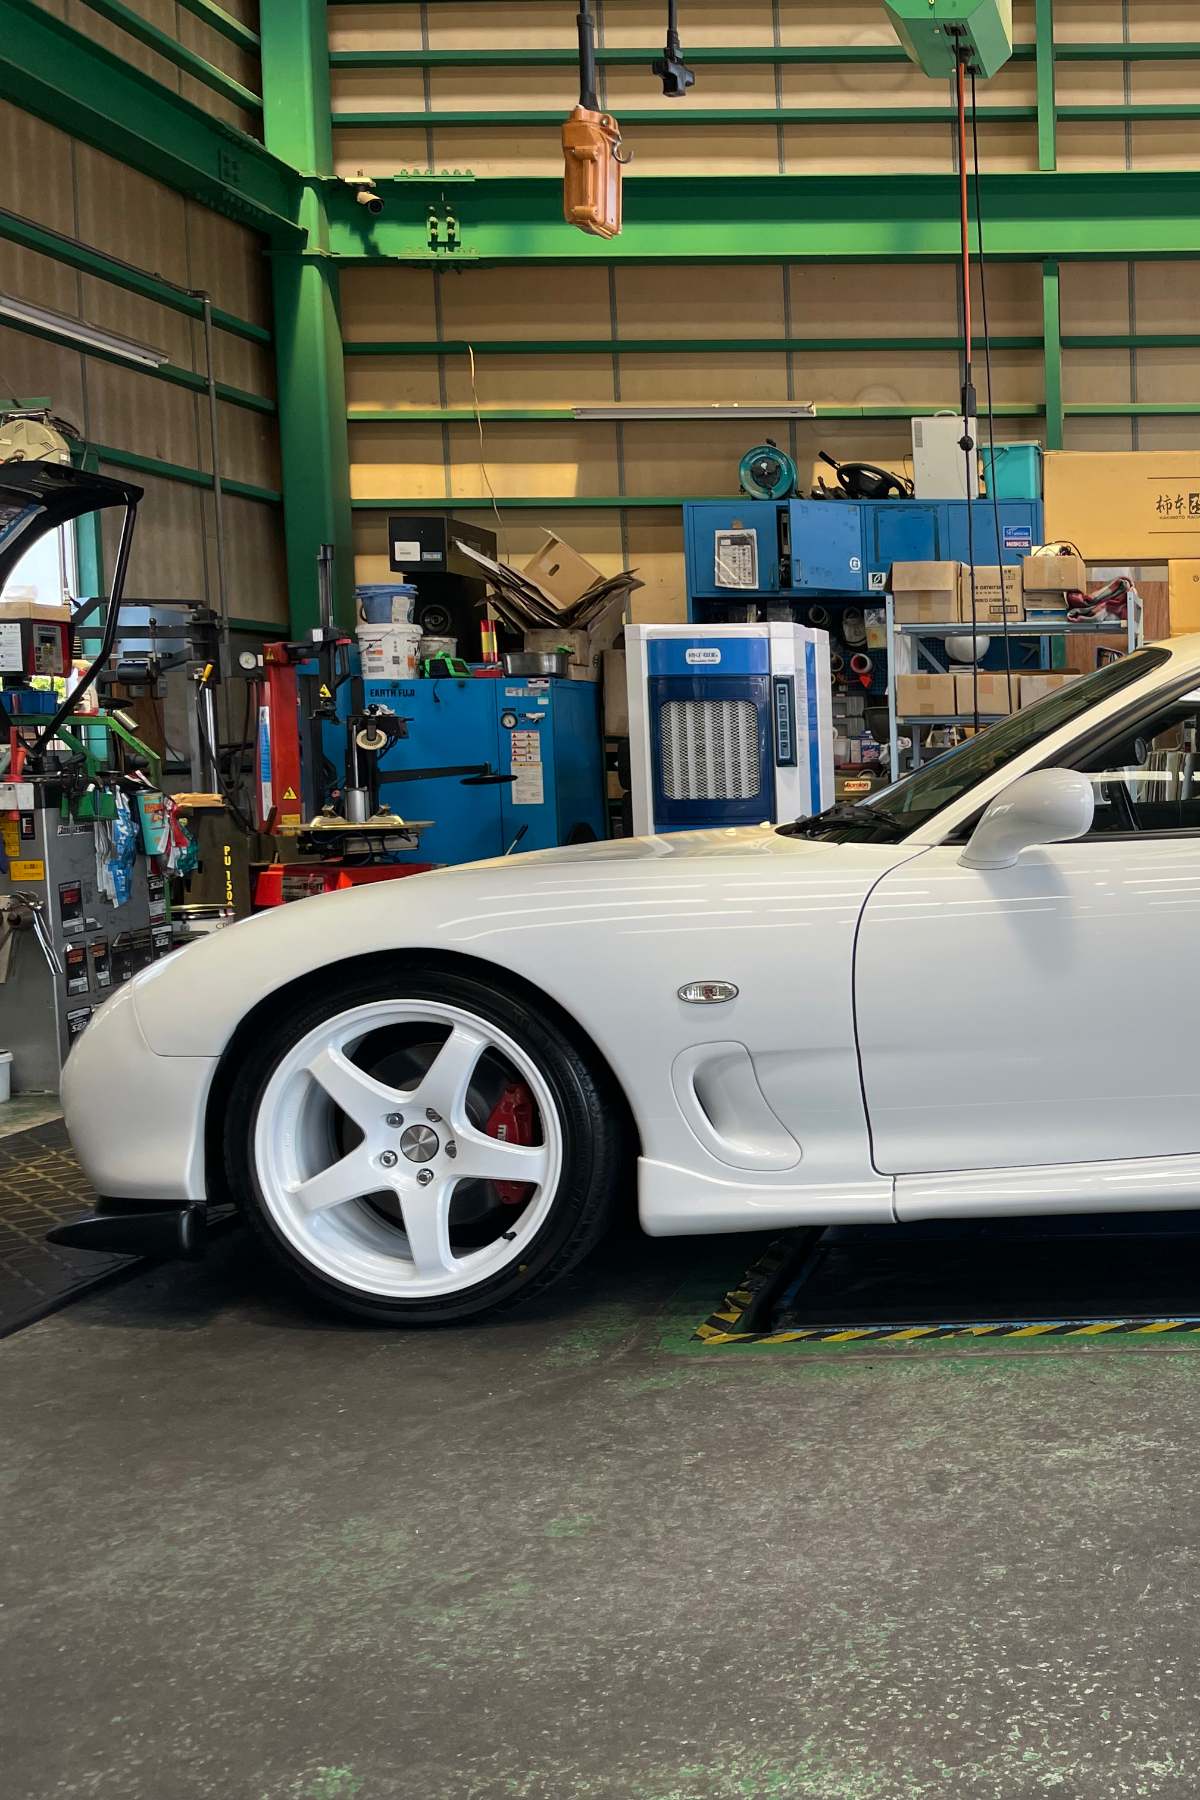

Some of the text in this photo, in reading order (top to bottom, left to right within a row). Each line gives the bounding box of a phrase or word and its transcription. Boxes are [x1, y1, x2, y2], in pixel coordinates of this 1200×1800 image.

[370, 689, 415, 697] EARTH FUJI
[223, 845, 231, 866] PU
